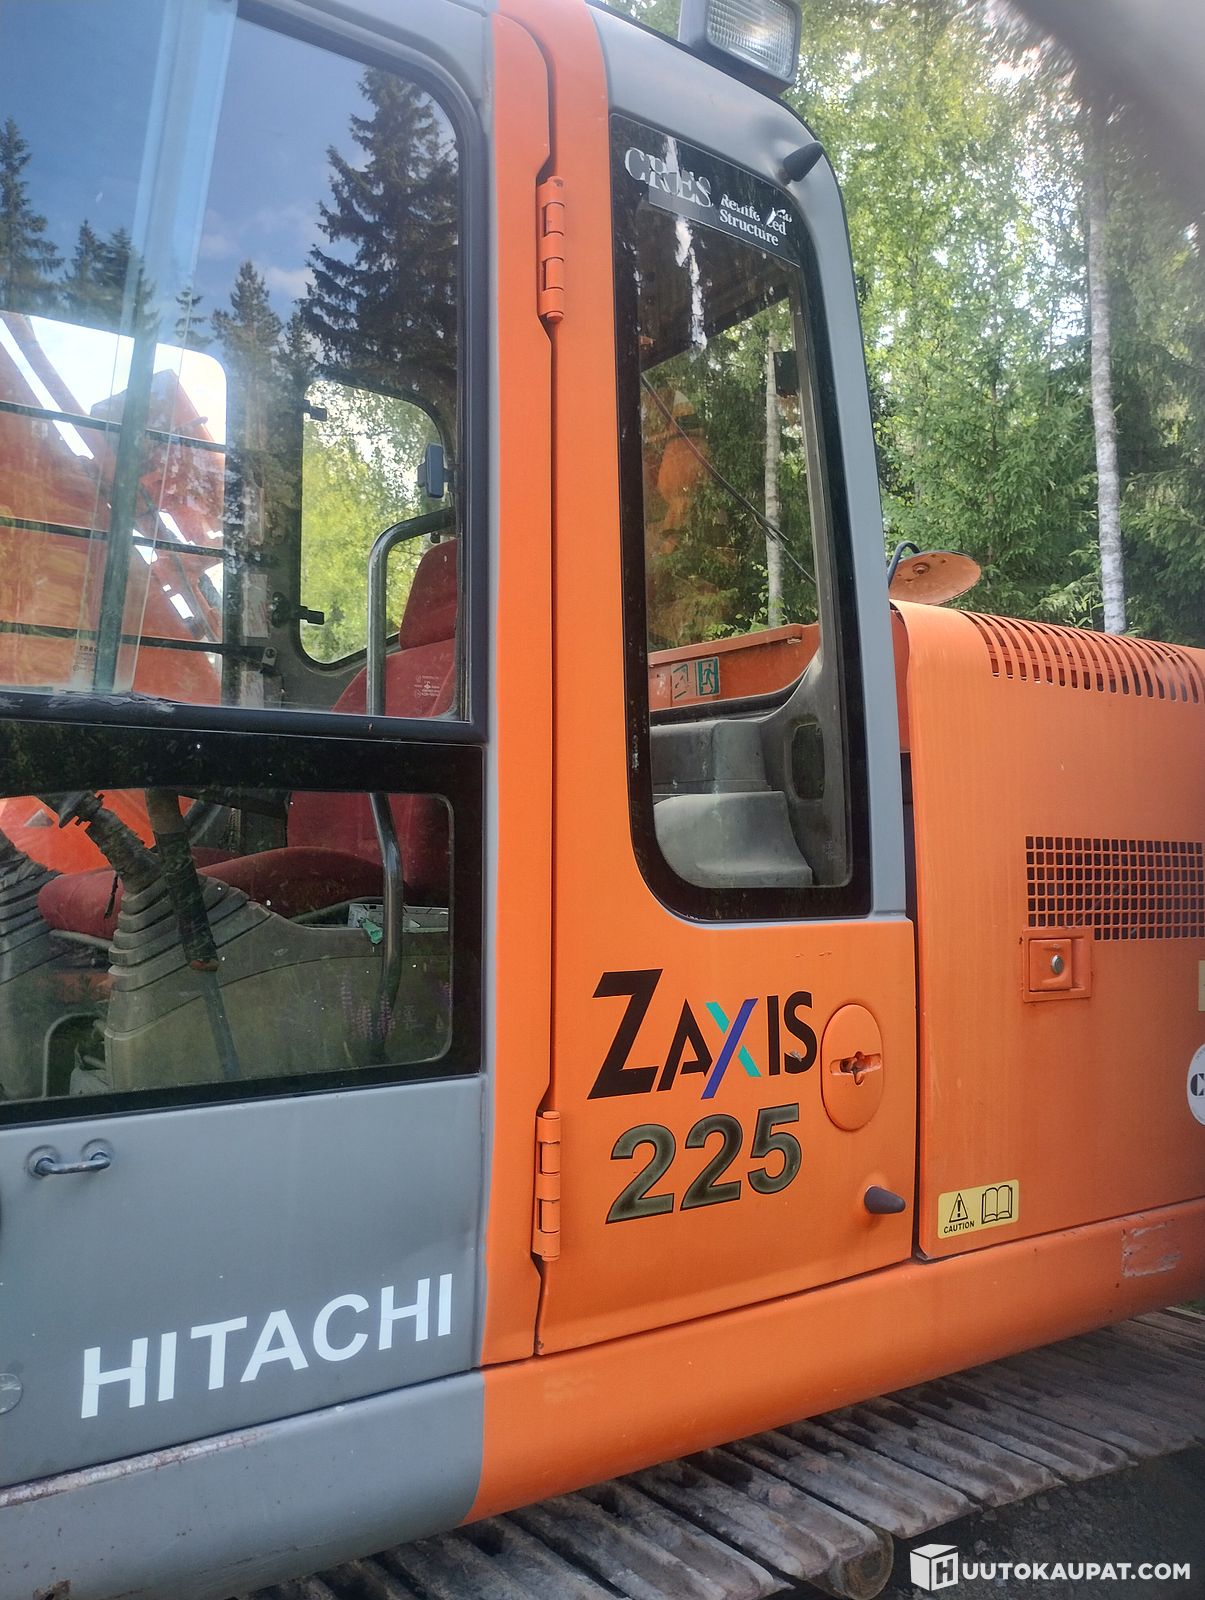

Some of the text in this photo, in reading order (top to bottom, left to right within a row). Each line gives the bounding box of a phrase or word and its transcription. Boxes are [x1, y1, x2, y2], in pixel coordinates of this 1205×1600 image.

[624, 146, 714, 208] CRES
[719, 209, 779, 246] Structure
[720, 193, 787, 235] Reinfoed
[587, 968, 817, 1100] ZAXIS
[605, 1102, 802, 1225] 225
[943, 1220, 975, 1234] CAUTION
[81, 1273, 453, 1419] HITACHI
